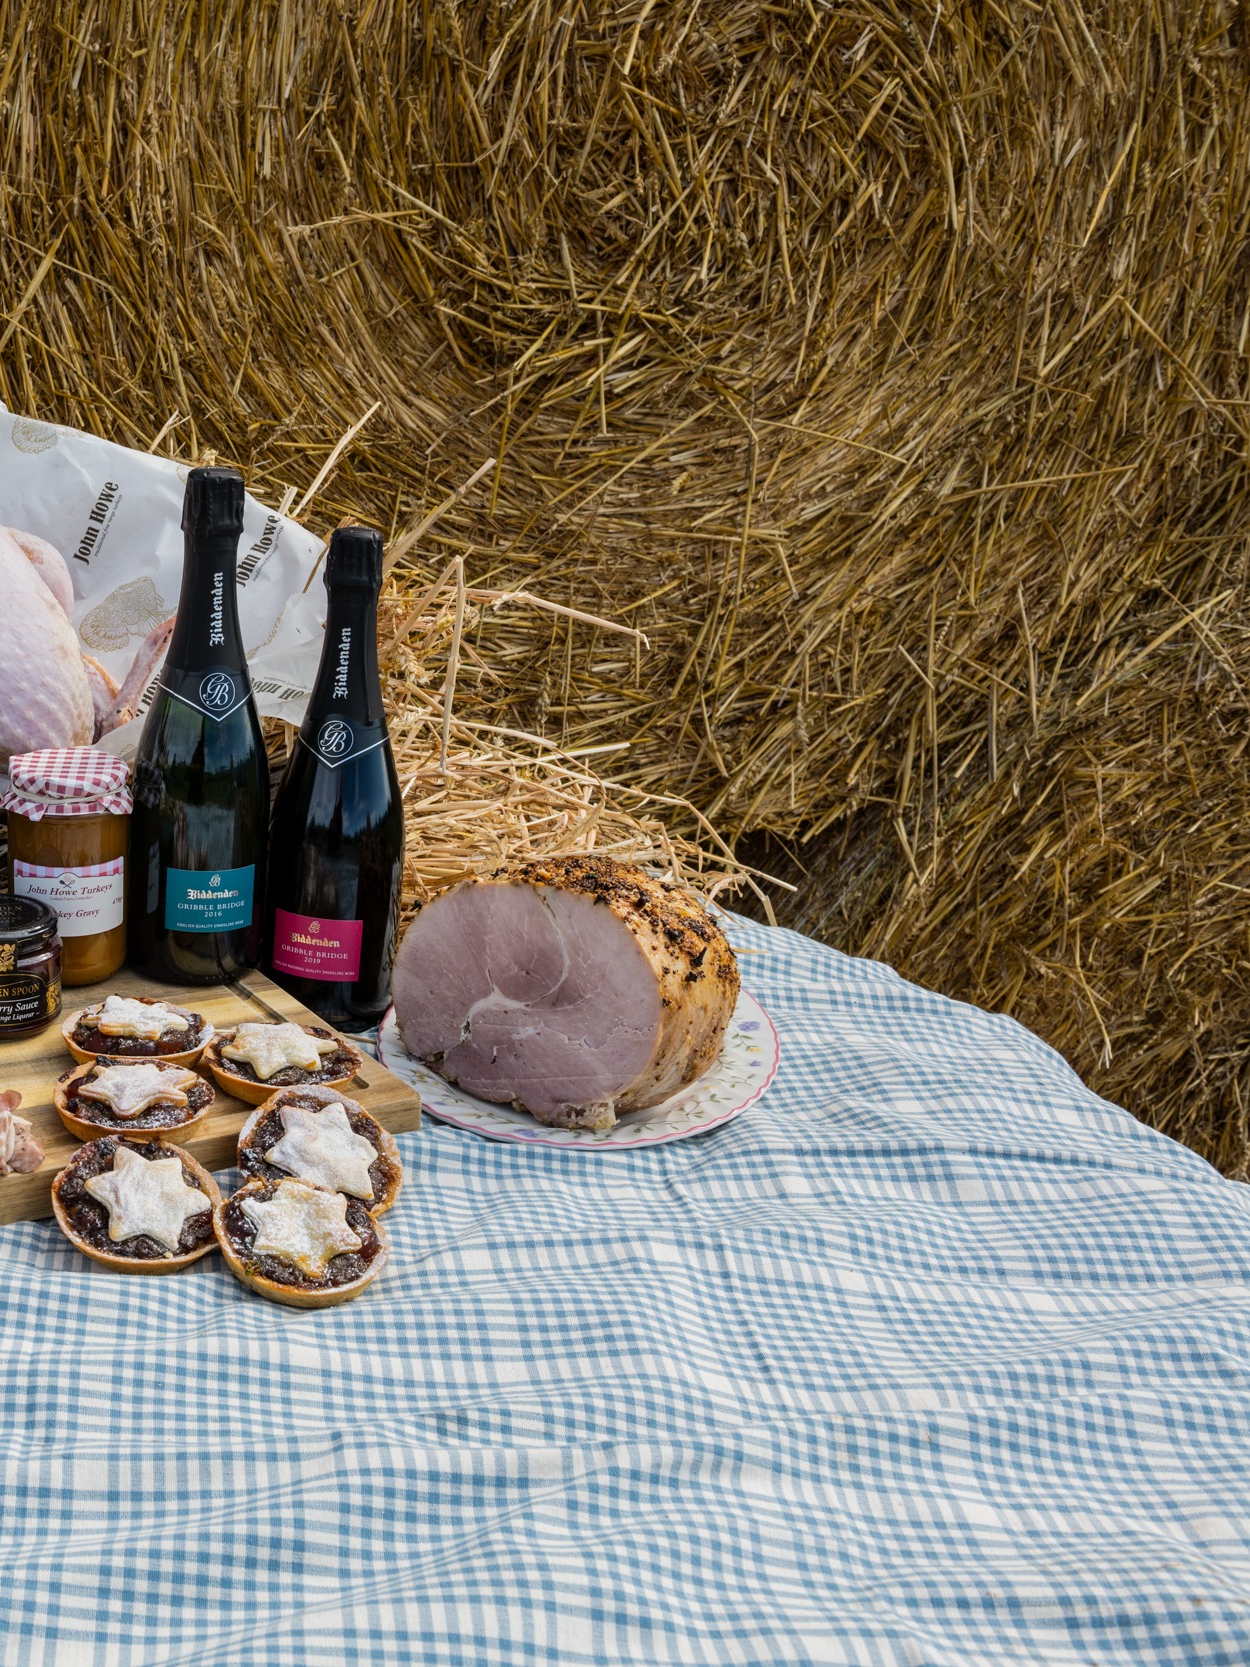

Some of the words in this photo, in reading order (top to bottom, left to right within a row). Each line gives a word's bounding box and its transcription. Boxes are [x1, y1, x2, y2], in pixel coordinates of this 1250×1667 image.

[73, 526, 100, 566] John
[89, 481, 119, 525] Howe
[236, 554, 261, 588] John
[250, 515, 281, 555] Howe
[209, 571, 225, 647] Biddenden
[333, 627, 352, 700] Biddenden
[27, 884, 48, 895] John
[49, 887, 78, 896] Howe
[80, 883, 113, 895] Turkeys
[186, 888, 239, 900] Biddenden
[177, 902, 214, 911] GRIBBLE
[217, 900, 245, 910] BRIDGE
[58, 910, 73, 920] key
[75, 908, 101, 918] Gravy
[290, 932, 341, 948] Biddenden
[281, 944, 314, 957] GRIBBLE
[316, 951, 349, 960] BRIDGE
[304, 956, 321, 964] 2019
[11, 982, 40, 997] SPOON
[15, 1000, 39, 1012] Sauce
[12, 1012, 35, 1021] Liqueur
